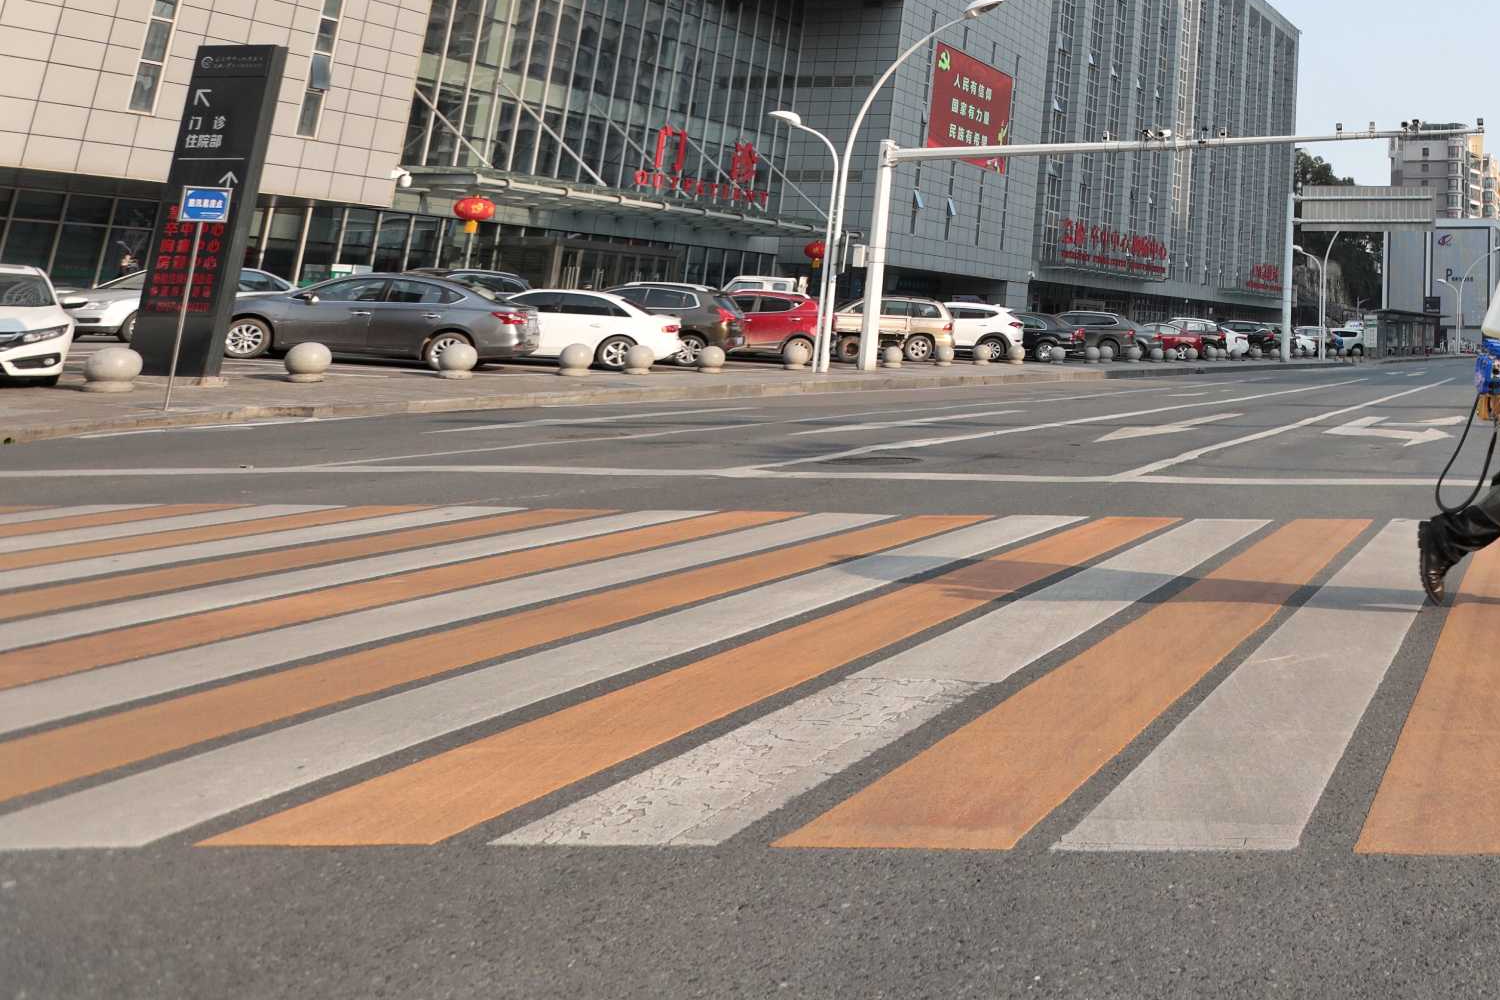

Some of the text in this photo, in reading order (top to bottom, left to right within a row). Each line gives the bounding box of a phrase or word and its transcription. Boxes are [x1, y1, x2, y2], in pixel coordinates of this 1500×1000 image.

[953, 72, 993, 101] 人民有信仰
[188, 115, 227, 130] 门诊
[951, 98, 990, 125] 国家有力量
[184, 134, 223, 149] 住院部
[948, 123, 988, 146] 民族有希望
